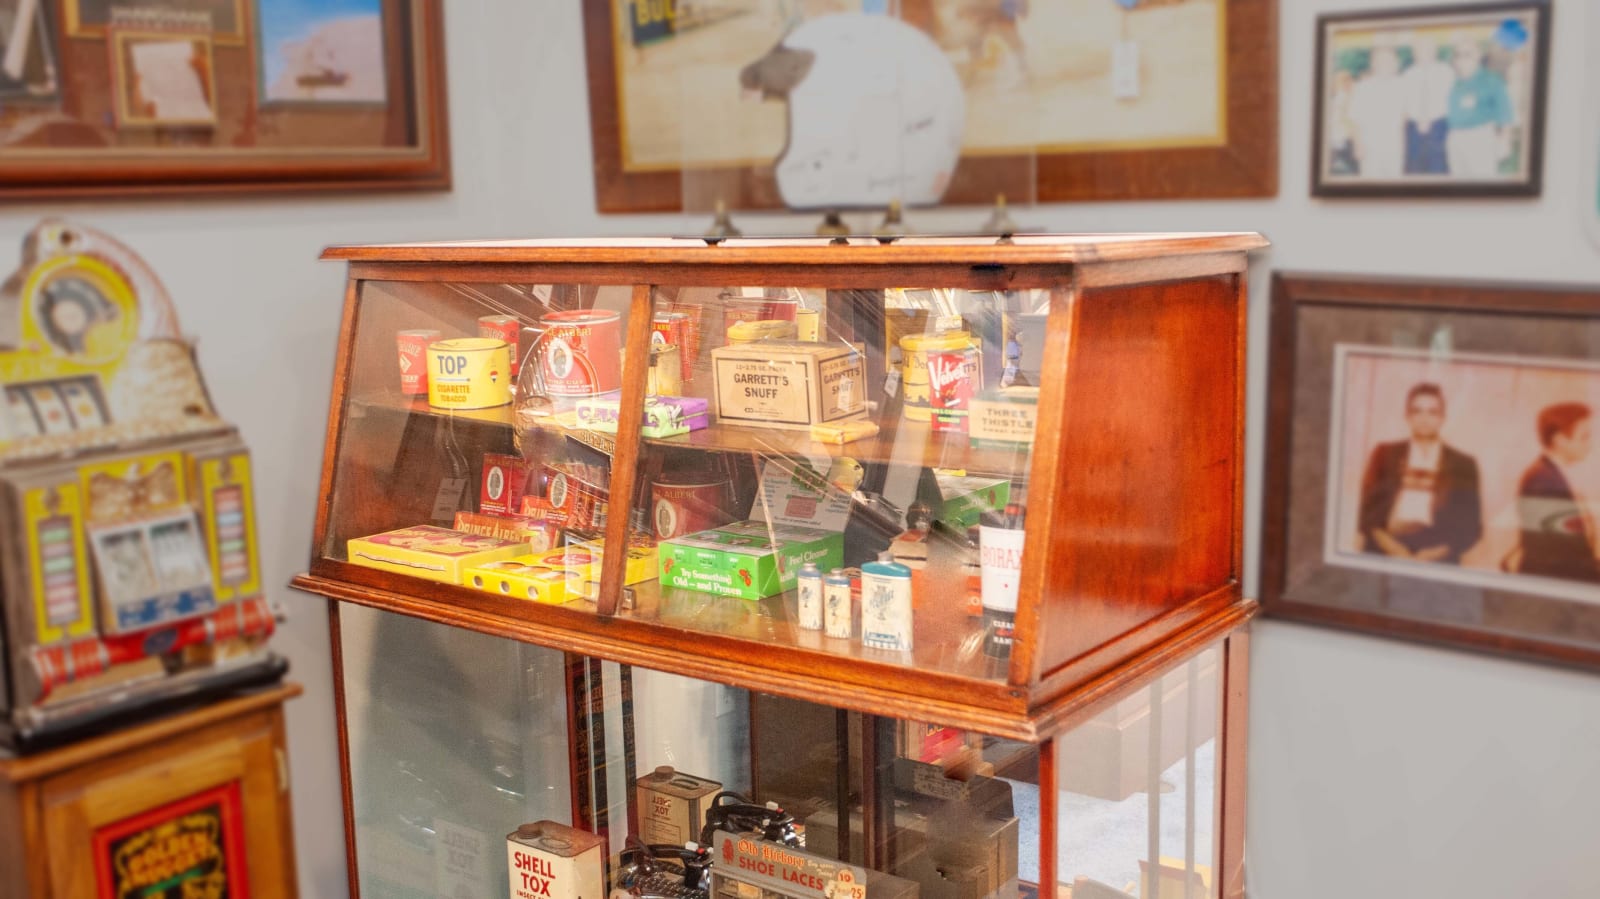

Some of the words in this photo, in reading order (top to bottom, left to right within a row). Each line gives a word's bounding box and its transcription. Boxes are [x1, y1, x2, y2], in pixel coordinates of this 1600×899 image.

[437, 355, 467, 375] TOP
[733, 373, 789, 386] GARRETT'S
[928, 356, 966, 398] Velvet
[437, 384, 471, 394] CIGARETTE
[744, 387, 778, 399] SNUFF
[986, 408, 1028, 418] THREE
[982, 418, 1034, 428] THISTLE
[457, 514, 491, 537] PRINCE
[680, 568, 691, 579] Try
[692, 568, 732, 585] Something
[673, 577, 689, 588] Old
[697, 580, 712, 592] and
[713, 582, 742, 596] Proven
[737, 838, 758, 857] Old
[761, 844, 805, 869] Hickory
[514, 851, 556, 880] SHELL
[738, 856, 775, 877] SHOE
[782, 867, 825, 891] LACES
[520, 871, 552, 898] TOX
